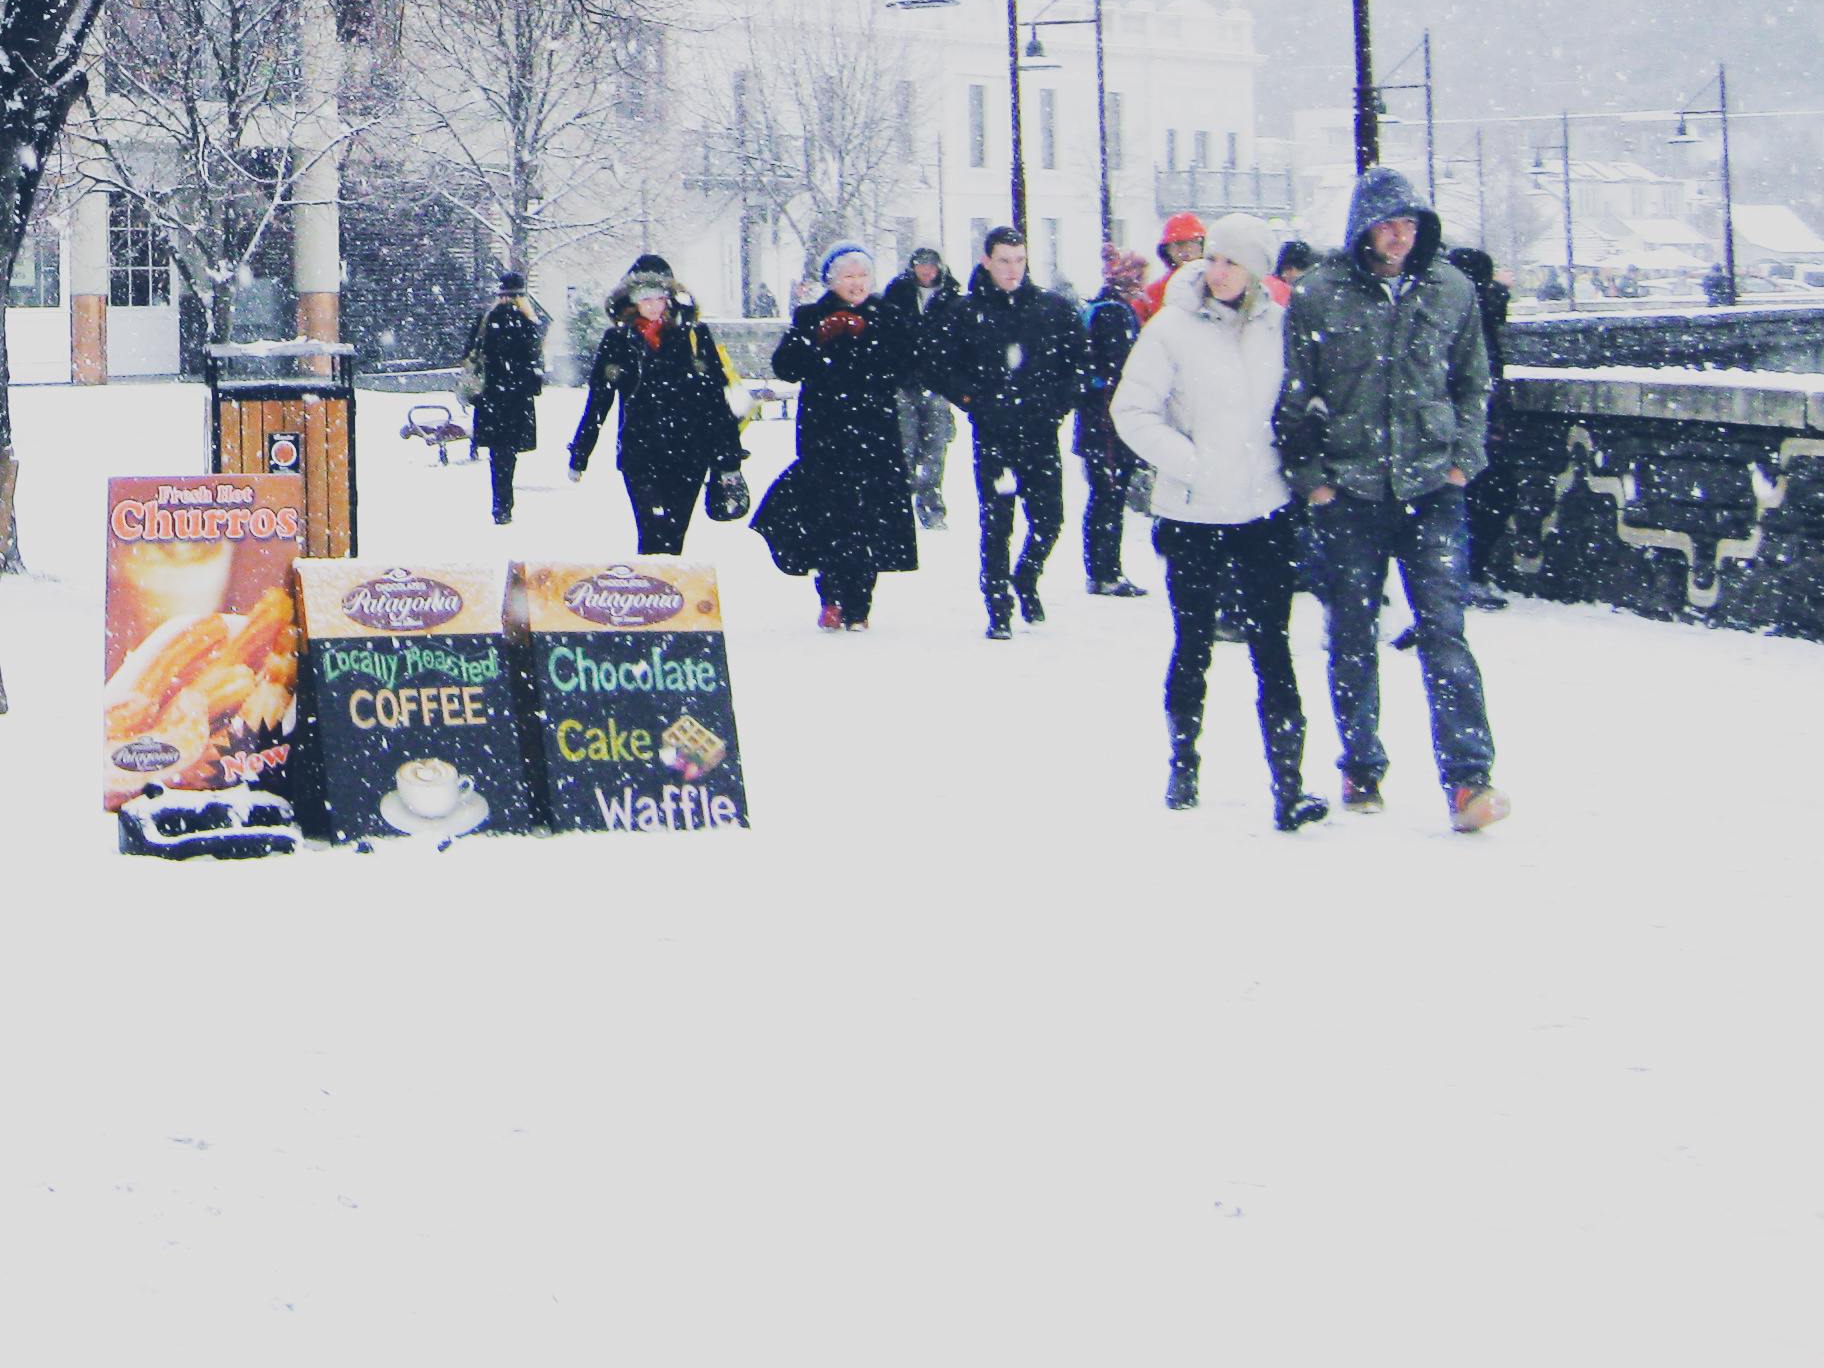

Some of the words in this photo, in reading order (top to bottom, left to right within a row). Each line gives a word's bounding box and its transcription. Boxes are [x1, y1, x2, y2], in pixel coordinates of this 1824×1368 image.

[158, 486, 213, 504] Fresh
[216, 485, 253, 504] Hot
[111, 499, 298, 541] Churros
[342, 588, 460, 620] Patagonia
[565, 582, 680, 616] Patagonia
[324, 649, 398, 689] Locally
[404, 646, 499, 683] Roasted
[548, 646, 716, 692] Chocolate
[349, 686, 487, 730] COFFEE
[557, 718, 654, 762] Cake
[594, 784, 739, 832] Waffle
